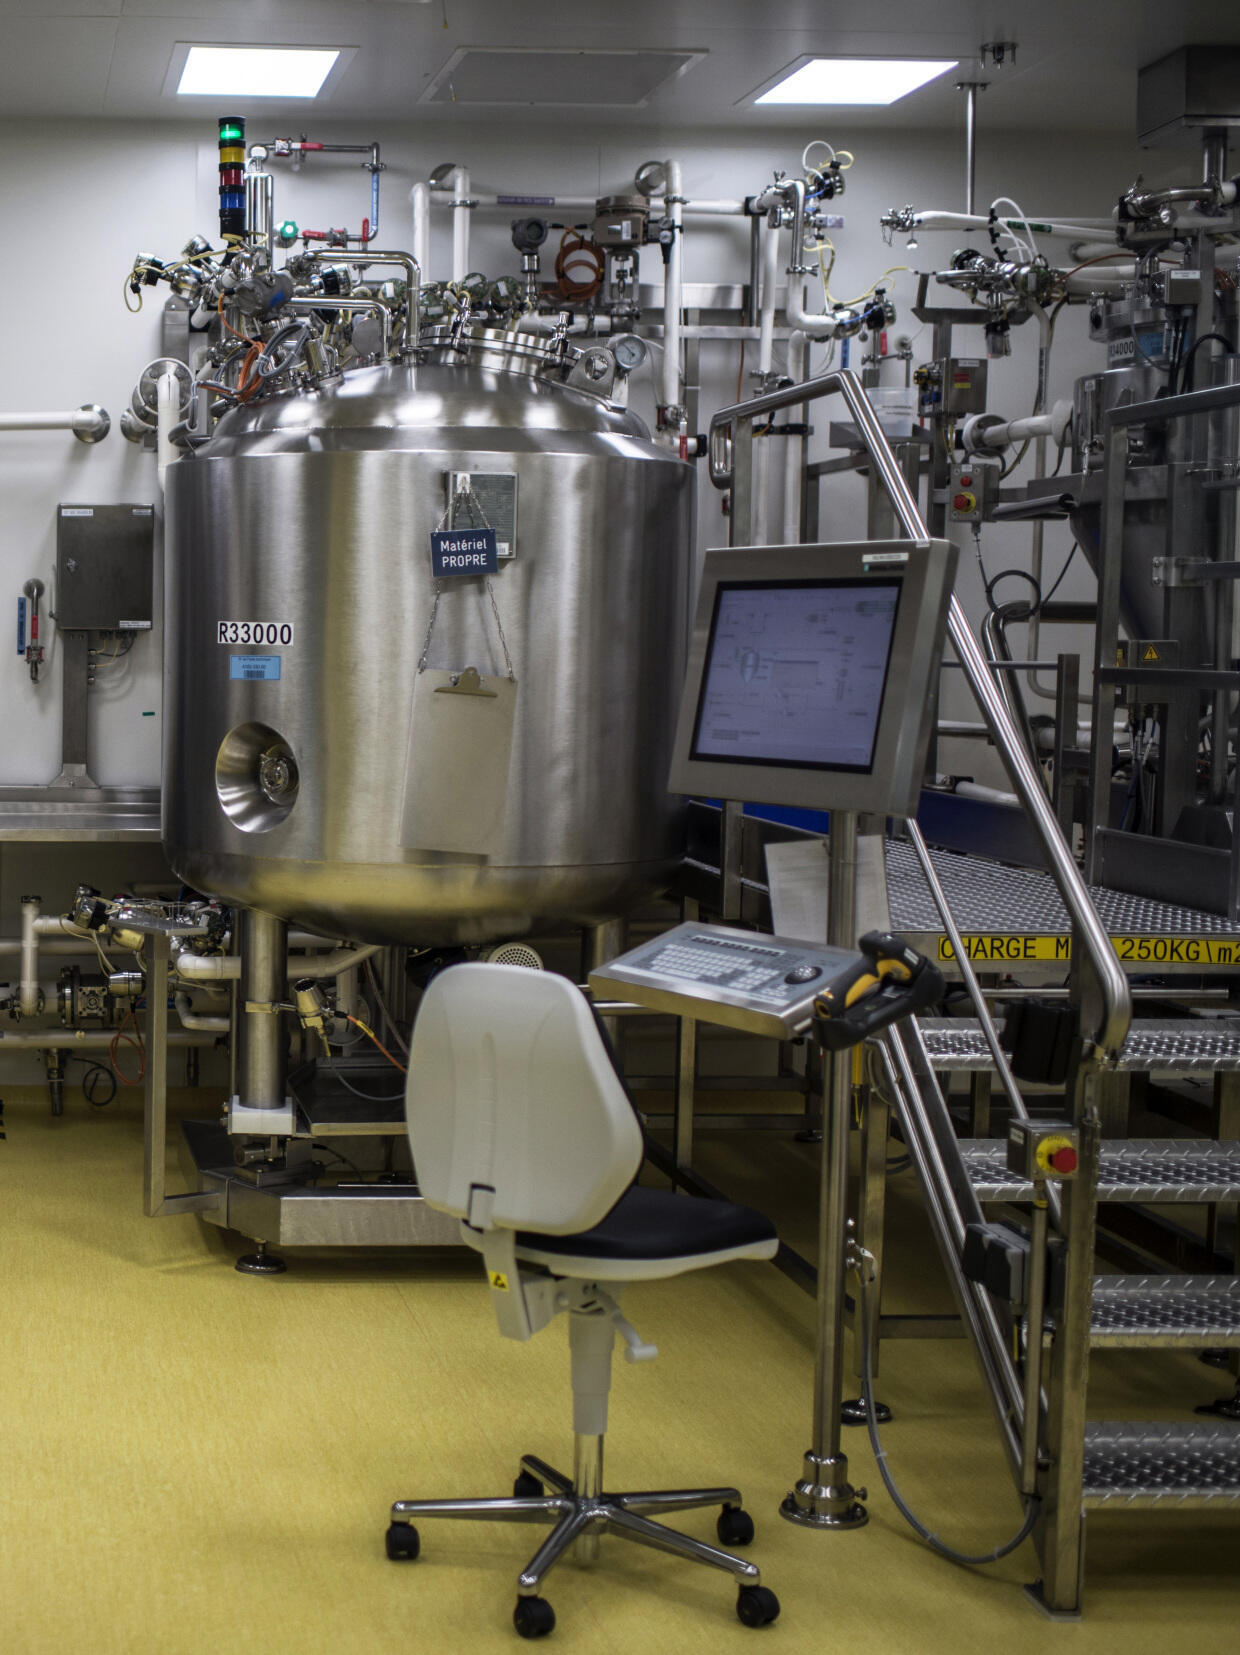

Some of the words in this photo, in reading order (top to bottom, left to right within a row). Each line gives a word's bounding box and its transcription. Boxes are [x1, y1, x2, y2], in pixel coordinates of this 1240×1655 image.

[440, 538, 487, 552] Matériel
[442, 554, 488, 567] PROPRE
[219, 622, 292, 644] R33000
